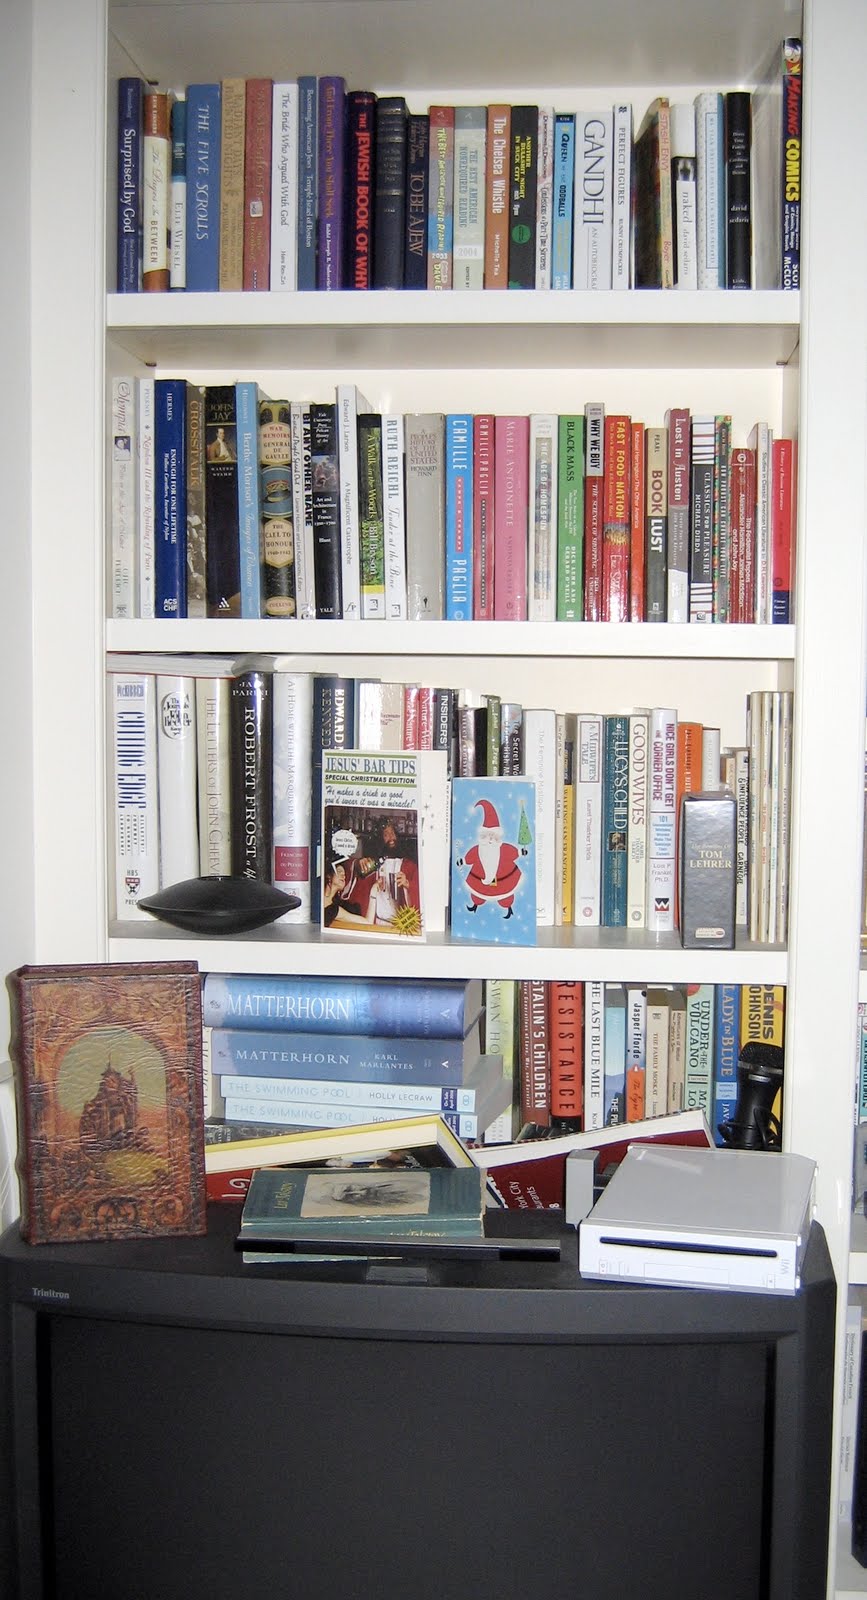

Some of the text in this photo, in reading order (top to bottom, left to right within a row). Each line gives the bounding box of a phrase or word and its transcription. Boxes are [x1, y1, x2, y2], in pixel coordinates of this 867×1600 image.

[787, 76, 801, 134] MAKING
[122, 128, 136, 190] Surprised
[278, 93, 290, 226] The Bride Who Argued With God
[492, 116, 506, 214] The Chelsea Whistle
[561, 134, 570, 162] QUEEN
[617, 127, 626, 206] PERFECT FIGURES
[196, 105, 210, 240] THE FIVE SCROLLS
[582, 119, 606, 226] GANDHI
[785, 138, 800, 201] COMICS
[121, 192, 135, 206] by
[355, 112, 369, 290] THE JEWISH BOOK OF WHY
[558, 185, 567, 218] ODDBALLS
[123, 208, 135, 234] God
[209, 404, 234, 412] JOHN
[213, 412, 231, 420] JAY
[189, 400, 199, 486] CROSSTALK
[367, 443, 377, 466] Walk
[452, 420, 467, 470] CAMILLE
[479, 418, 489, 496] CAMILLE PAGLIA
[540, 443, 548, 456] THE
[566, 421, 575, 454] BLACK
[590, 418, 600, 469] WHY WE BUY
[302, 413, 313, 526] BI ANY OTHER NAME
[386, 420, 398, 499] RUTH REICHL
[505, 420, 516, 527] MARIE ANTOINETTE
[540, 459, 548, 473] AGE
[566, 457, 575, 482] MASS
[615, 421, 625, 519] FAST FOOD NATION
[673, 418, 686, 501] Lost in Austen
[540, 476, 548, 486] OF
[703, 472, 711, 514] CLASSICS
[368, 489, 378, 518] Woods
[540, 489, 548, 530] HOMESPUN
[651, 470, 663, 553] BOOK LUST
[693, 494, 701, 528] MICHAEL
[368, 526, 378, 576] Bill Bryson
[591, 527, 598, 535] OF
[703, 531, 711, 575] PLEASURE
[452, 559, 467, 602] PAGLIA
[334, 689, 345, 743] EDWARD
[326, 757, 416, 774] JESUS' BAR TIPS
[582, 742, 591, 765] TALE
[631, 723, 646, 825] GOOD WIVES
[653, 741, 663, 776] CORNER
[665, 722, 675, 808] NICE GIRLS DON'T GET
[244, 707, 257, 858] ROBERT FROST
[325, 774, 349, 782] SPECIAL
[350, 775, 387, 783] CHRISTMAS
[613, 740, 628, 828] LUCY'S CHILD
[653, 778, 663, 801] OFFICE
[658, 815, 668, 823] 101
[689, 860, 732, 869] LEHRER
[698, 850, 722, 859] TOM
[736, 852, 744, 885] CARNEGIE
[226, 994, 351, 1021] MATTERHORN
[532, 980, 547, 1109] STALIN'S CHILDREN
[591, 981, 601, 1098] HE LAST BLUE MILE
[632, 1003, 642, 1059] Jasper Fforde
[689, 1001, 701, 1068] VOLCANO
[700, 1000, 710, 1065] UNDER THE
[721, 985, 735, 1077] LADY IN BLUE
[235, 1049, 351, 1065] MATTERHORN
[359, 1062, 414, 1070] MARLANTES
[374, 1053, 399, 1061] KARL
[369, 1092, 397, 1100] HOLLY
[398, 1093, 433, 1102] LECRAW
[611, 1097, 619, 1112] THE
[32, 1287, 70, 1299] Trinitron
